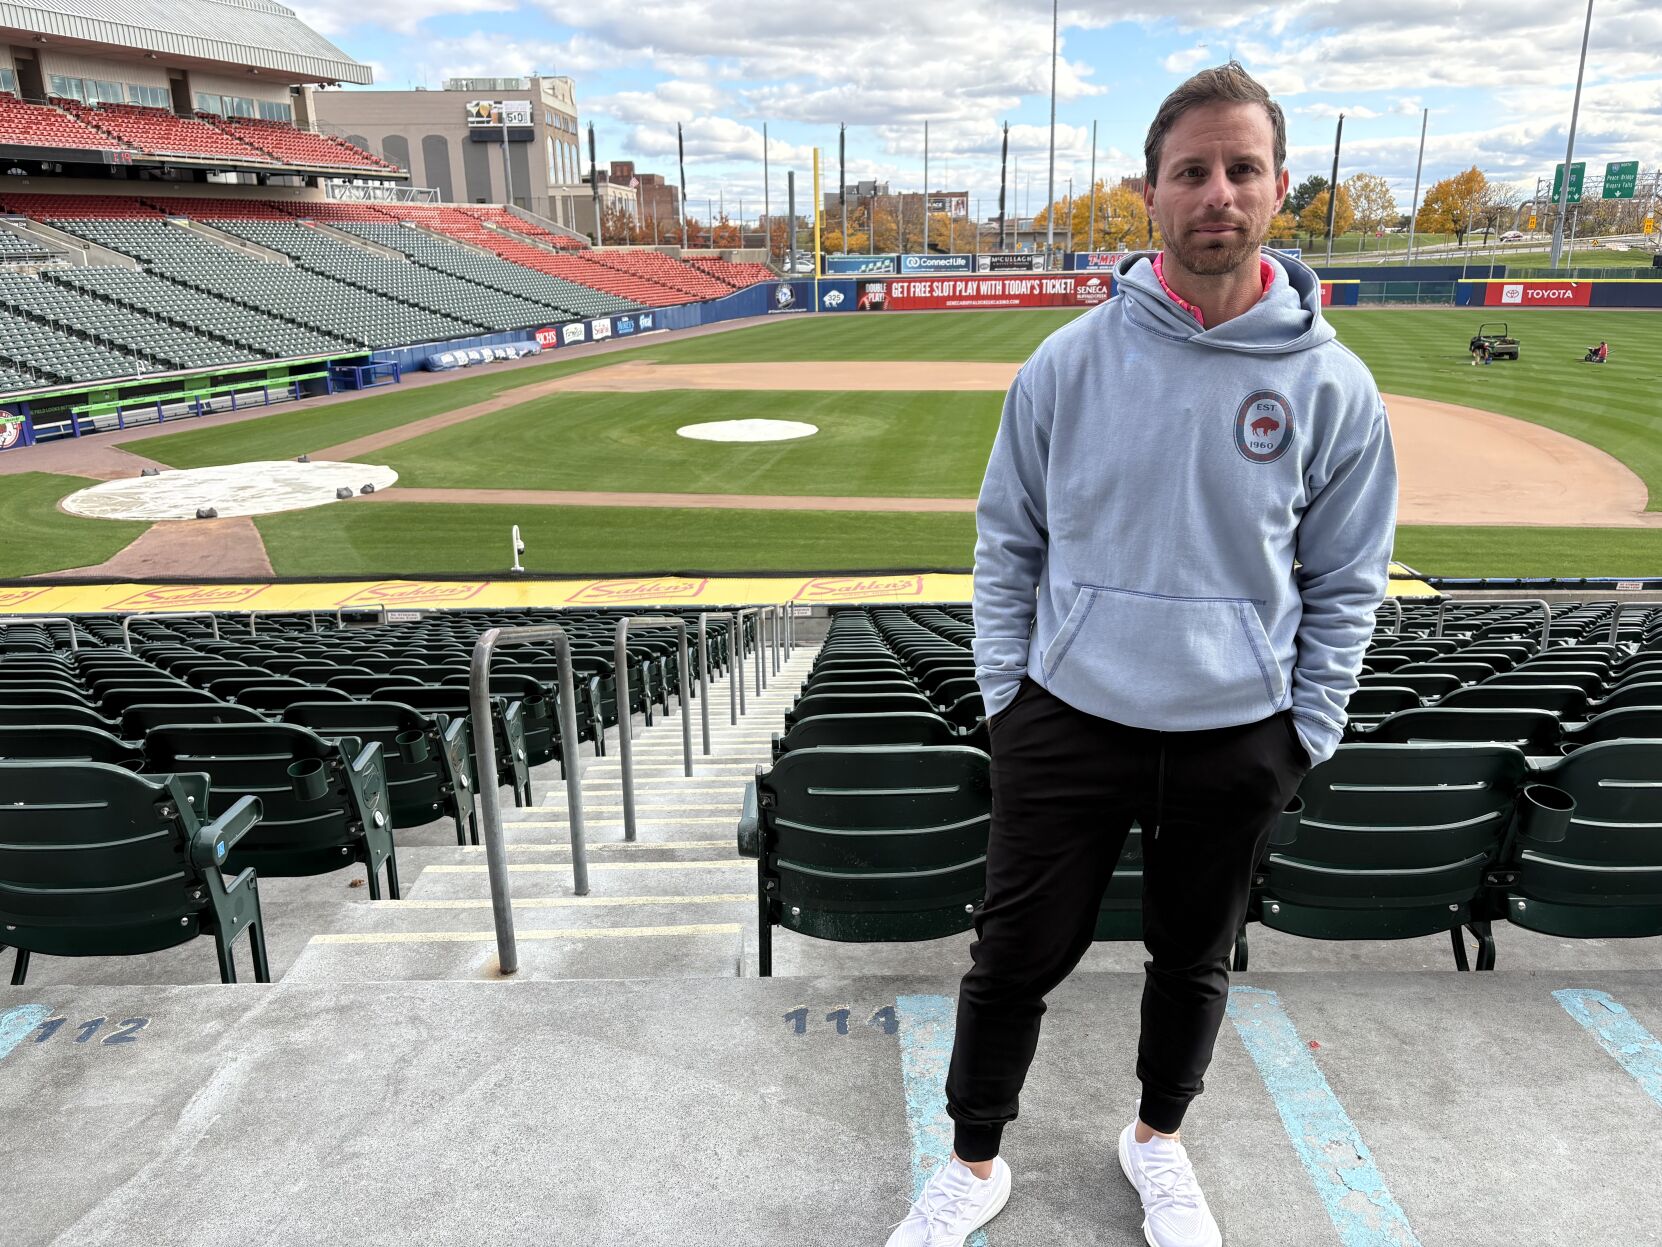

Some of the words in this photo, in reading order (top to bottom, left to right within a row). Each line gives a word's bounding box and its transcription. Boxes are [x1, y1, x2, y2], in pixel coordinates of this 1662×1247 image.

[921, 257, 966, 266] ConnectLife
[865, 283, 887, 293] DOUBLE
[892, 283, 909, 297] GET
[910, 282, 931, 297] FREE
[932, 281, 955, 296] SLOT
[956, 280, 979, 296] PLAY
[980, 280, 1003, 295] WITH
[1004, 279, 1040, 295] TODAY'S
[1041, 279, 1075, 294] TICKET!
[1527, 289, 1573, 298] TOYOTA
[868, 293, 885, 302] PLAY!
[536, 331, 557, 344] RICH'S
[1250, 441, 1274, 449] 1960
[355, 584, 474, 600] Sahlen's
[584, 581, 695, 597] Sahlen's
[808, 579, 913, 595] Sahlen's
[127, 587, 254, 604] Sahlen's
[782, 1005, 899, 1035] 114
[34, 1016, 151, 1045] 112
